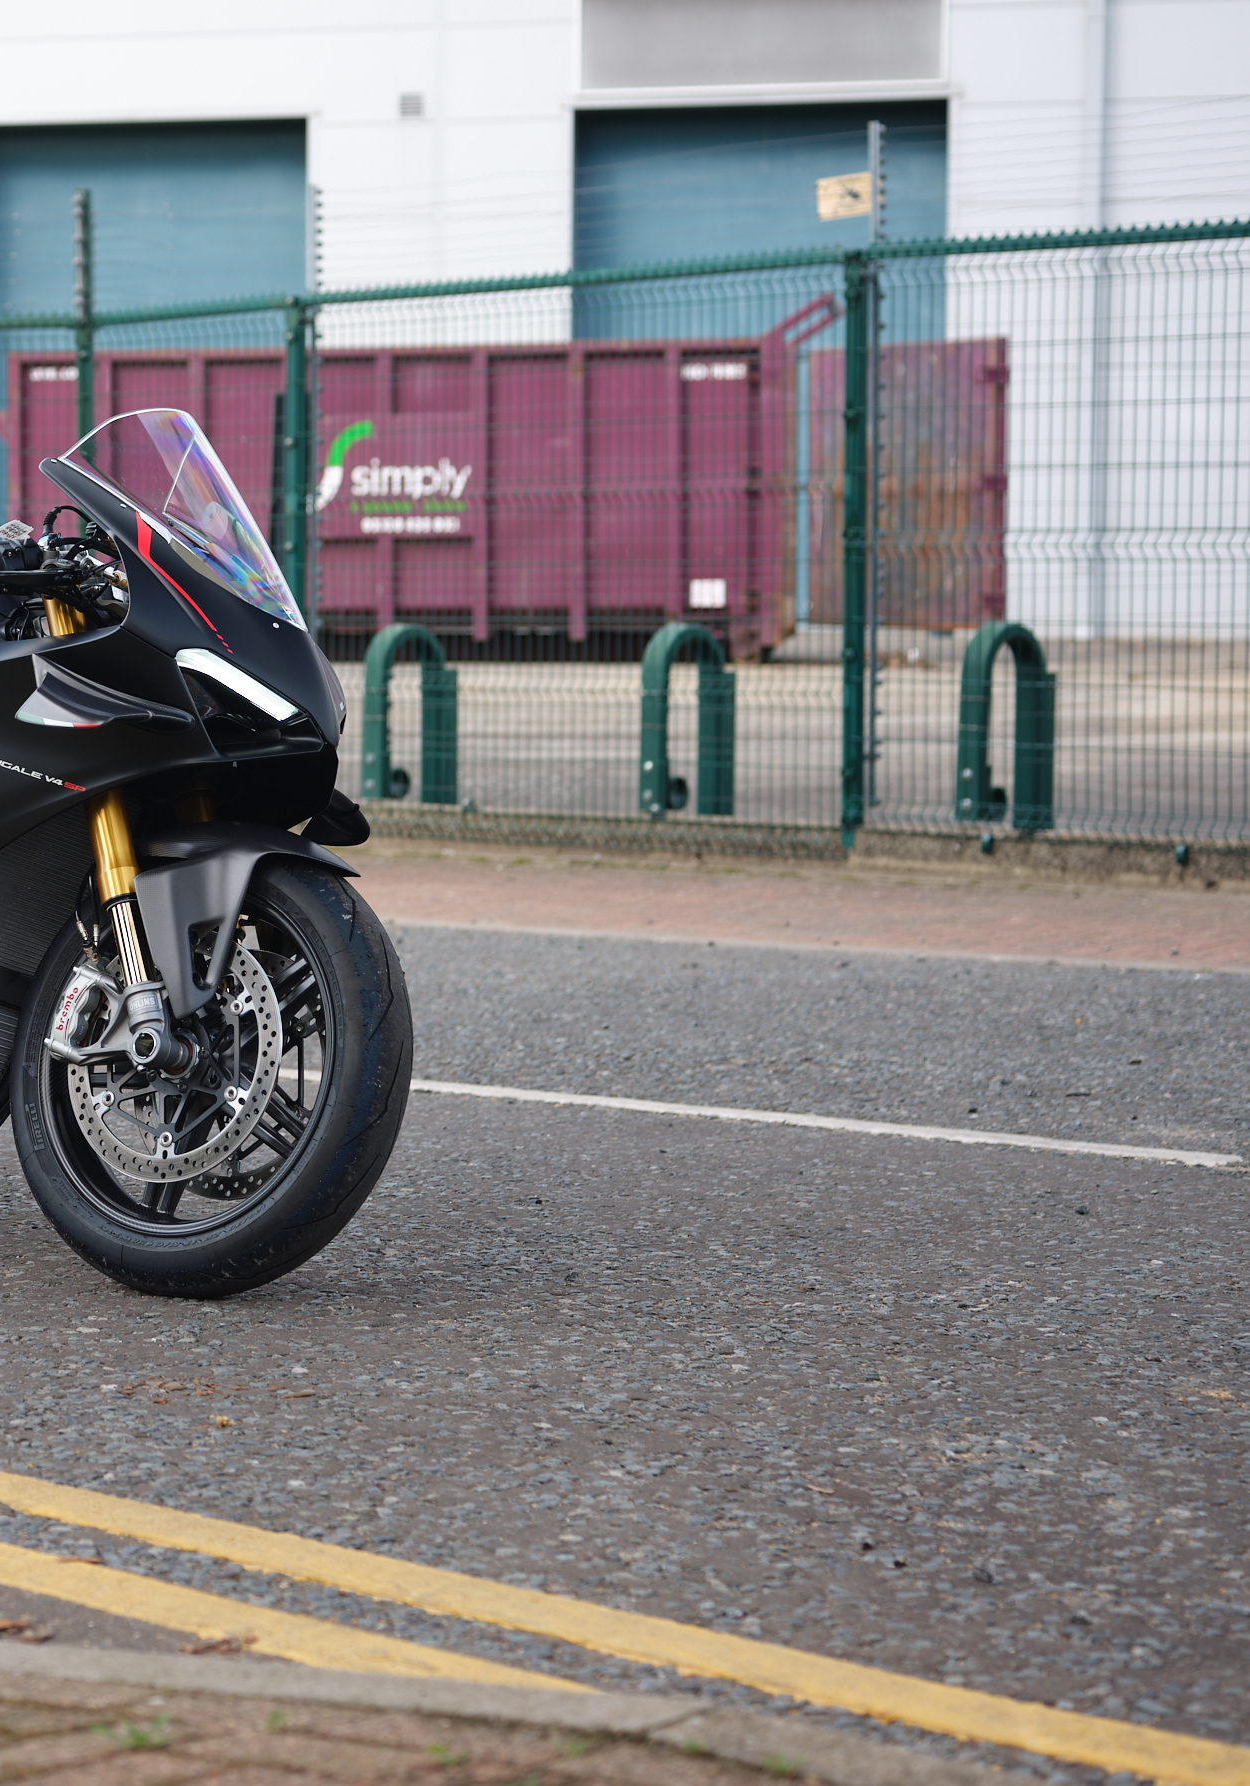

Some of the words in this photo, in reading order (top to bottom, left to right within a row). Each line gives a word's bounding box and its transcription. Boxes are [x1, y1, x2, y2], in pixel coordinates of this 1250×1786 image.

[351, 457, 472, 499] simply
[56, 987, 79, 1031] brembo
[25, 1103, 45, 1150] PIRELLI
